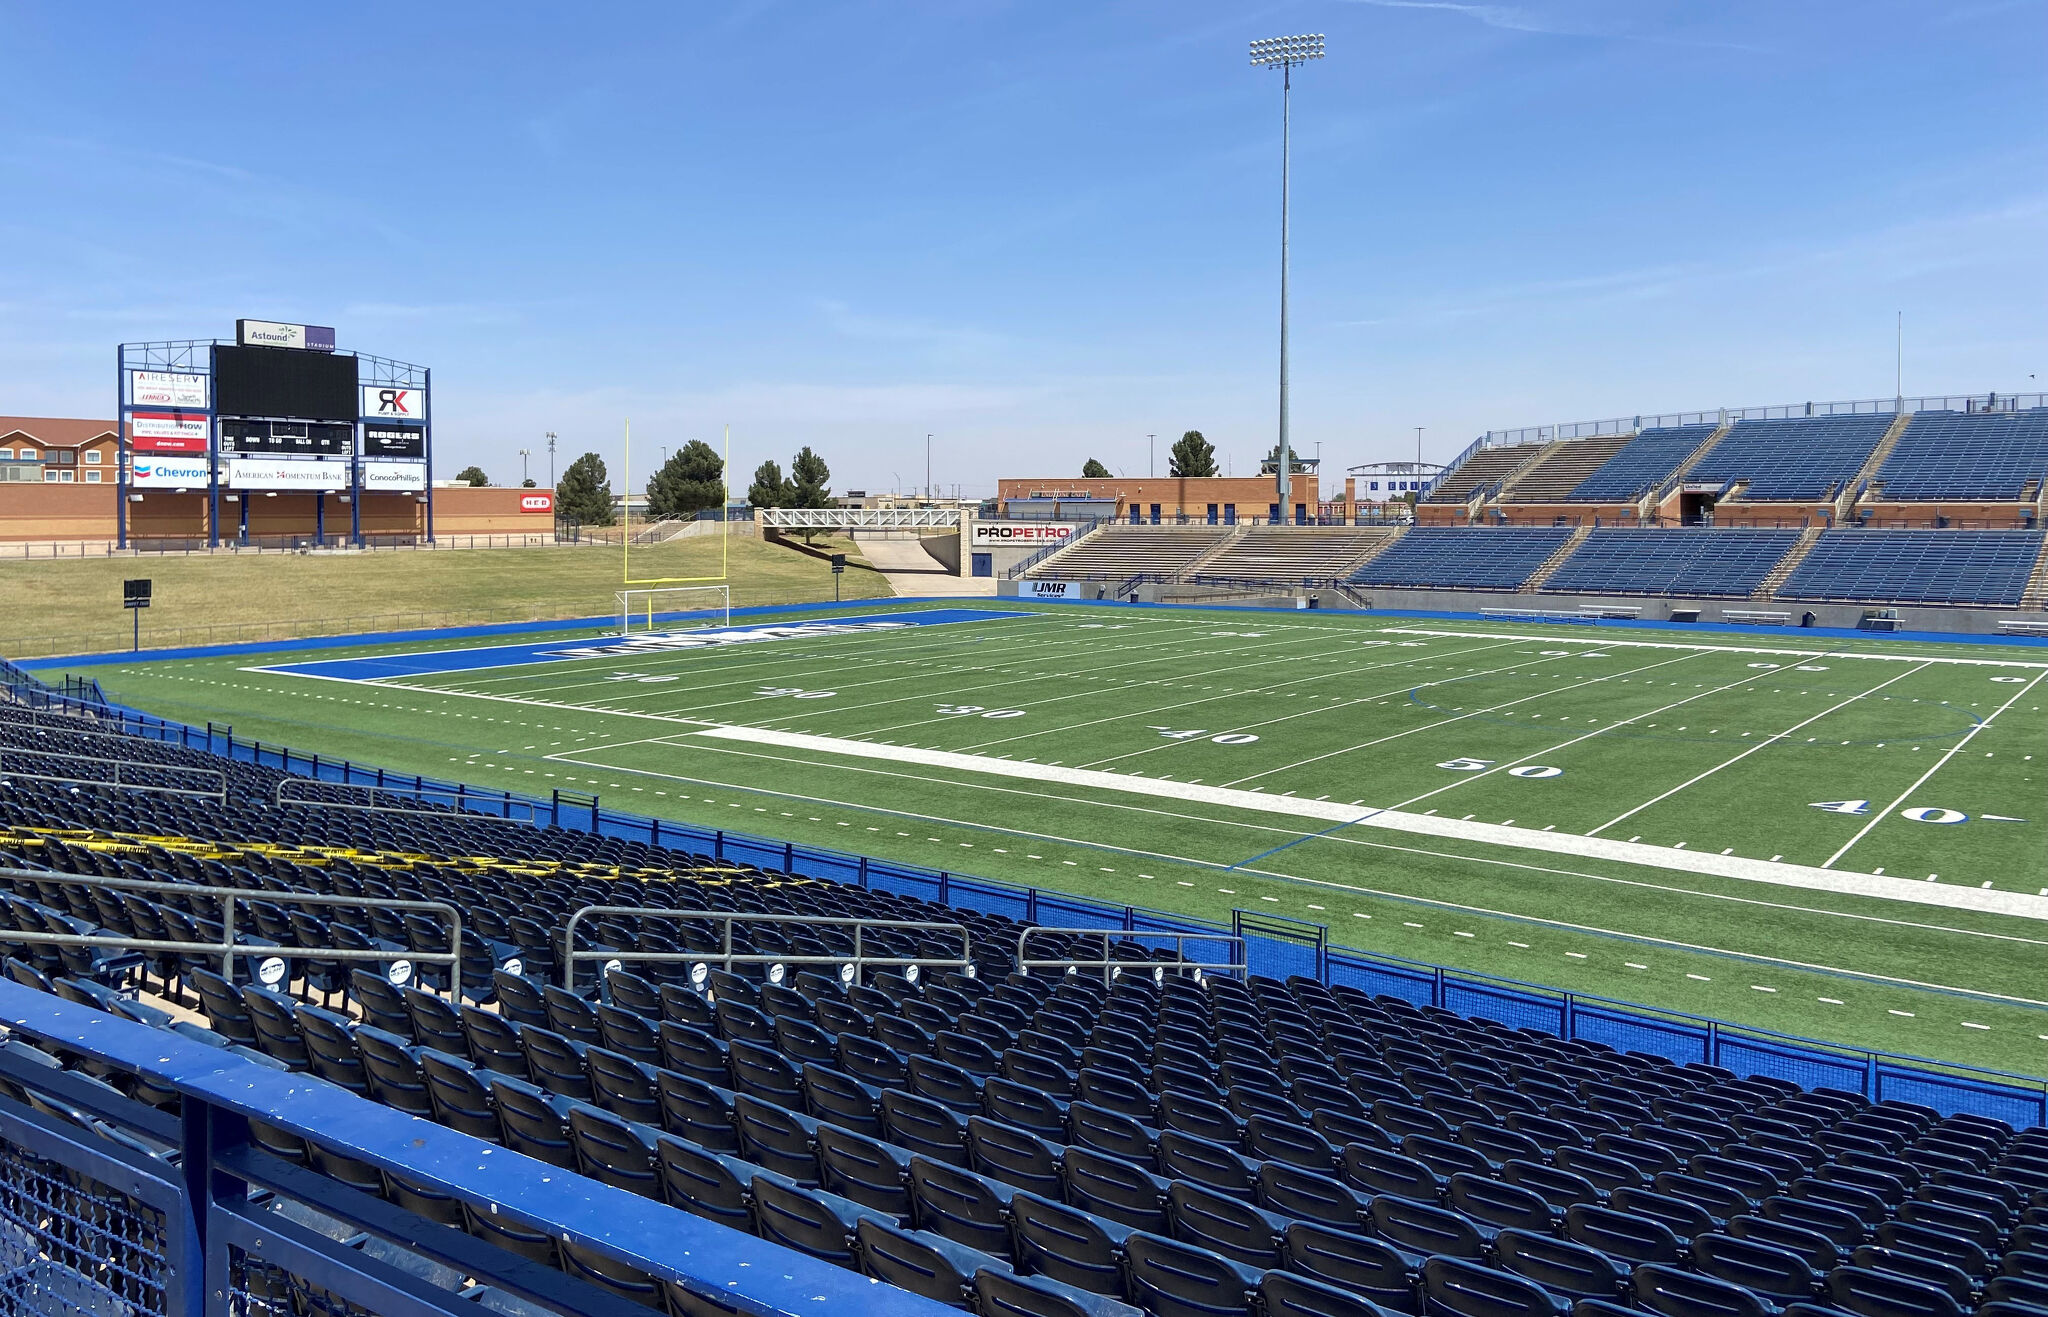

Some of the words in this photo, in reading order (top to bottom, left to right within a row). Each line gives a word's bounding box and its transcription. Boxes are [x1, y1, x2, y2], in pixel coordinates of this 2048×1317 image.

[251, 331, 288, 342] Astound
[368, 430, 420, 440] ROGERS
[155, 466, 207, 478] Chevron
[234, 469, 274, 479] AMERICAN
[322, 471, 342, 481] BANK
[369, 473, 420, 483] ConocoPhillips
[977, 527, 1070, 538] PROPETRO
